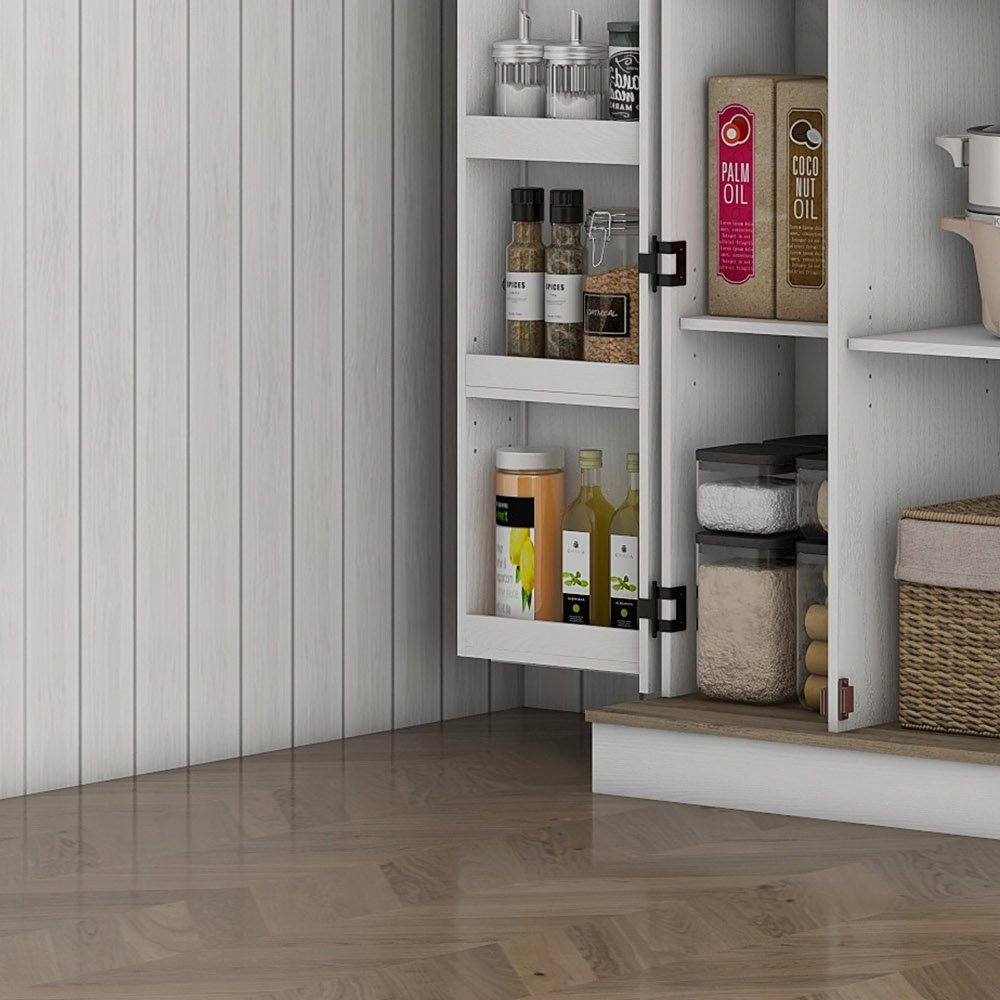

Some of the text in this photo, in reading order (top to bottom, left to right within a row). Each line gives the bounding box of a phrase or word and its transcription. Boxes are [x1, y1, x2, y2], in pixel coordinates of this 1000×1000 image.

[721, 161, 750, 183] PALM
[792, 155, 819, 177] COCO
[723, 183, 748, 205] OIL
[795, 177, 816, 198] NUT
[793, 198, 818, 220] OIL
